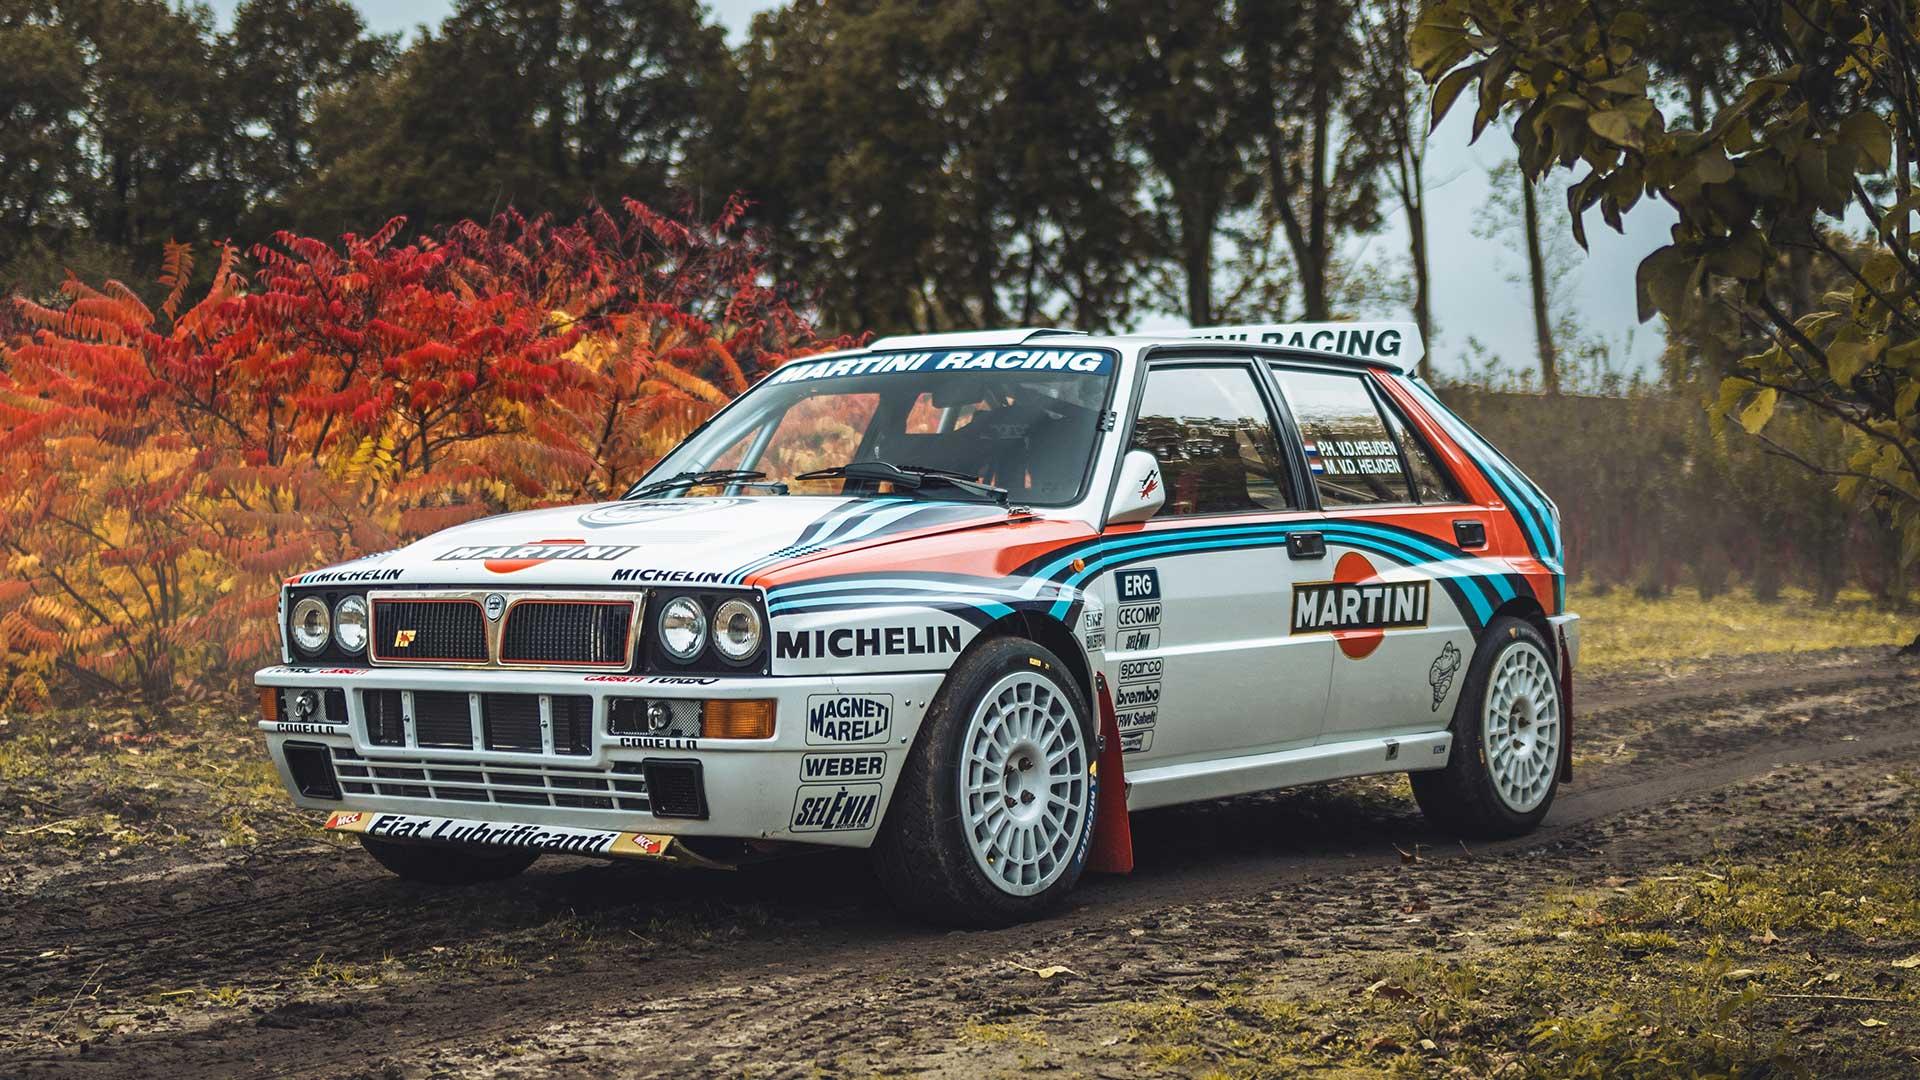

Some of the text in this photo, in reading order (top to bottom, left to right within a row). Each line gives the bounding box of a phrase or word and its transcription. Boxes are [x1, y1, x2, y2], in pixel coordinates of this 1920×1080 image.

[770, 351, 1104, 385] MARTINI RACING
[1323, 459, 1339, 475] M.
[1359, 459, 1401, 474] HEIJDEN
[438, 546, 637, 560] MARTINI
[315, 569, 404, 582] MICHELIN
[611, 569, 722, 583] MICHELIN
[1124, 574, 1152, 596] ERG
[1119, 606, 1160, 625] CECOMP
[1295, 586, 1426, 628] MARTINI
[776, 625, 962, 659] MICHELIN
[1121, 661, 1161, 680] sparco
[1117, 686, 1159, 705] brembo
[805, 756, 883, 776] WEBER
[336, 815, 358, 826] MCC
[369, 815, 617, 853] Fiat Lubrificanti
